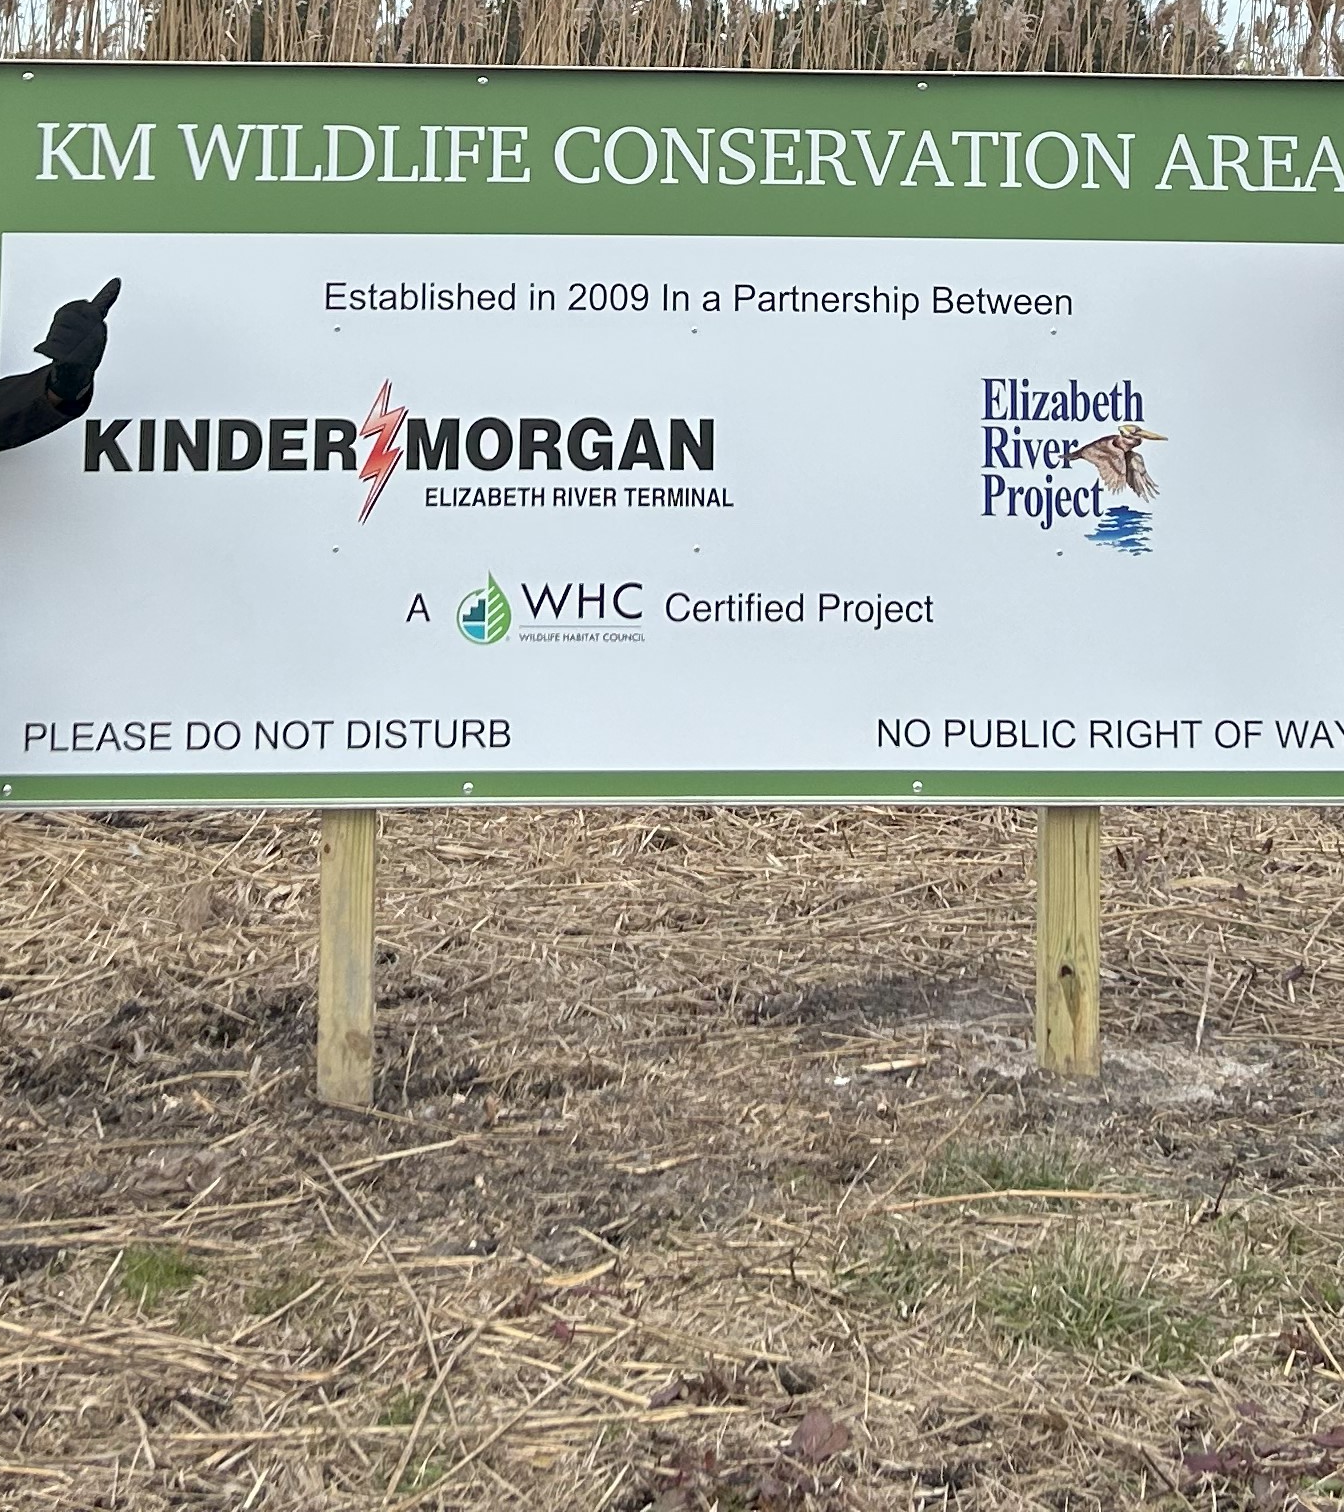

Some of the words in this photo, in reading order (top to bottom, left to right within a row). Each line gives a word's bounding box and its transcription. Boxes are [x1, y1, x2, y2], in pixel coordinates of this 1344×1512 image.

[36, 123, 156, 180] KM
[178, 124, 530, 182] WILDLIFE
[555, 127, 1135, 189] CONSERVATION
[326, 283, 515, 310] Established
[530, 283, 554, 310] in
[568, 283, 648, 311] 2009
[664, 284, 688, 311] In
[703, 291, 720, 311] a
[735, 285, 919, 320] Partnership
[934, 287, 1072, 315] Between
[981, 379, 1145, 422] Elizabeth
[83, 417, 358, 473] KINDER
[406, 417, 715, 472] MORGAN
[981, 426, 1079, 469] River
[426, 487, 544, 506] ELIZABETH
[554, 487, 616, 506] RIVER
[624, 488, 734, 507] TERMINAL
[981, 474, 1104, 529] Project
[406, 593, 430, 622] A
[521, 583, 642, 619] WHC
[666, 593, 803, 622] Certified
[819, 594, 933, 630] Project
[519, 633, 559, 641] WILDLIFE
[563, 633, 599, 641] HABITAT
[603, 633, 645, 642] COUNCIL
[25, 722, 171, 751] PLEASE
[187, 721, 240, 750] DO
[256, 721, 334, 749] NOT
[348, 720, 510, 749] DISTURB
[879, 719, 930, 747] NO
[945, 719, 1075, 748] PUBLIC
[1090, 720, 1202, 748] RIGHT
[1215, 720, 1263, 748] OF
